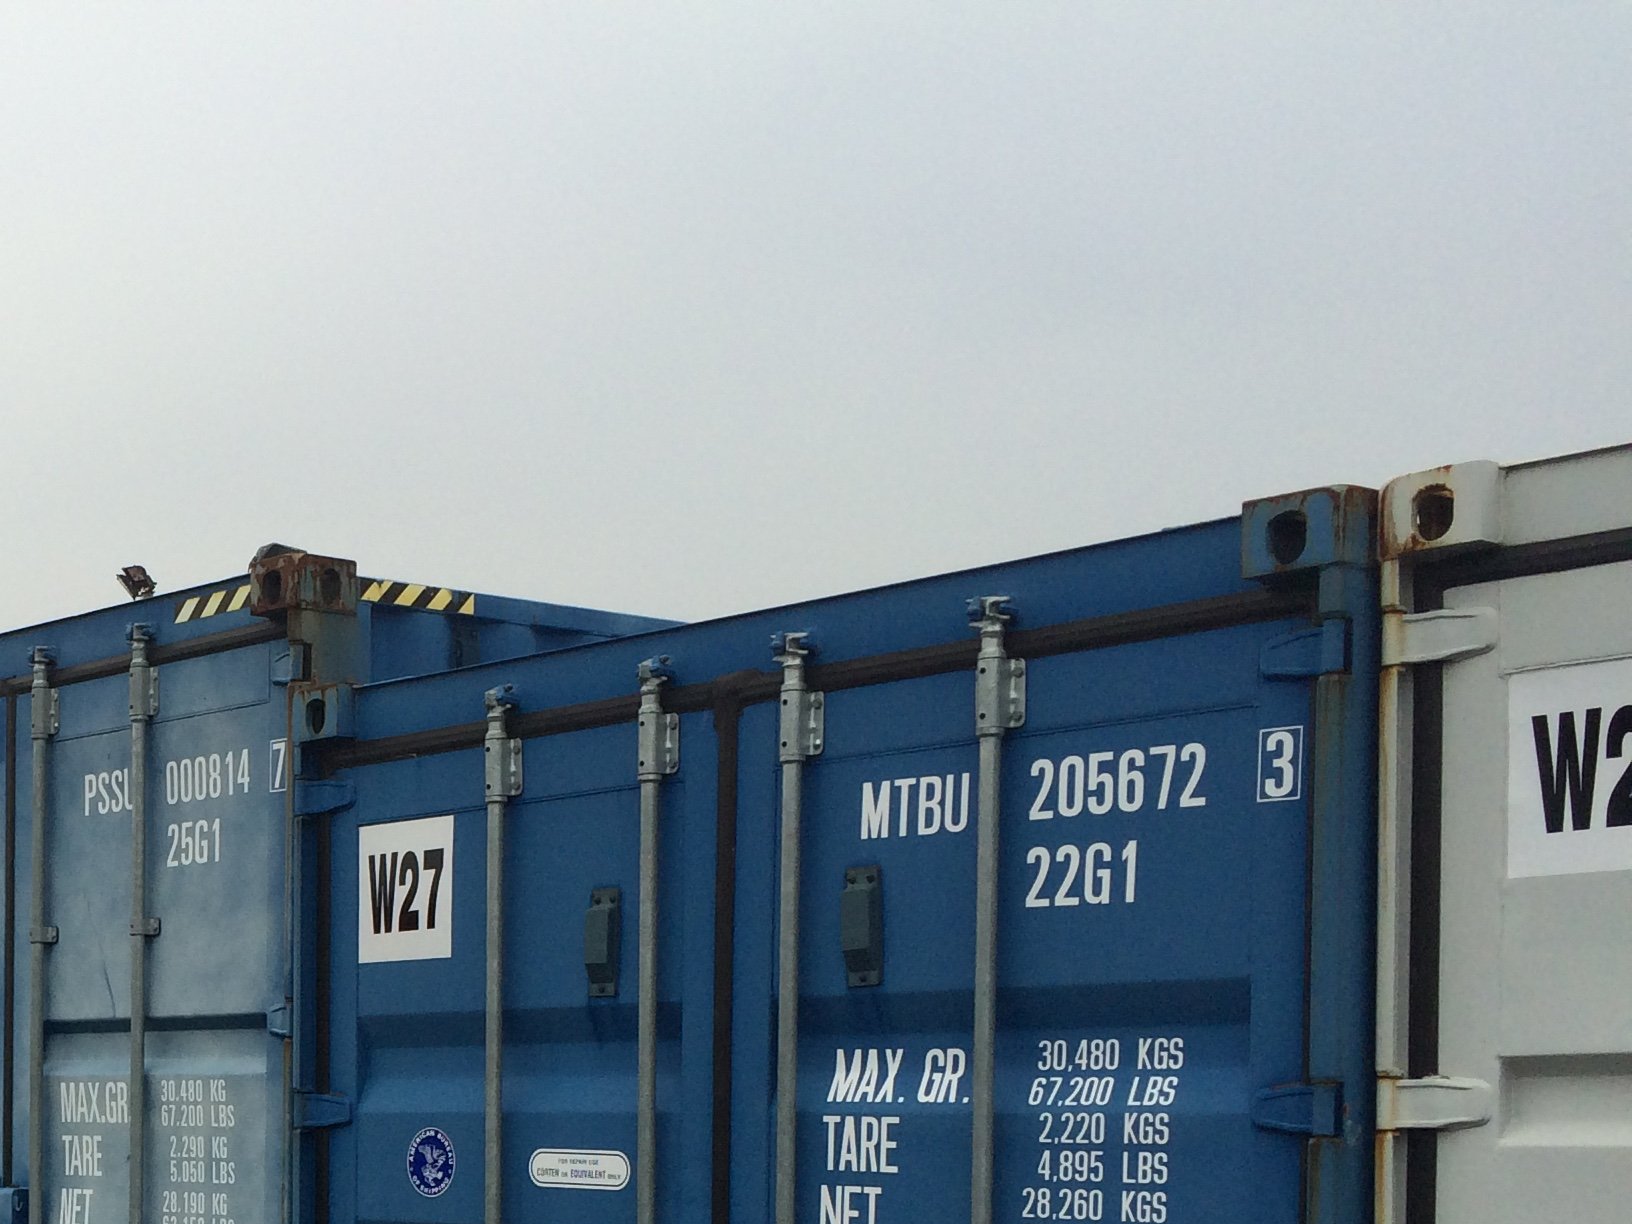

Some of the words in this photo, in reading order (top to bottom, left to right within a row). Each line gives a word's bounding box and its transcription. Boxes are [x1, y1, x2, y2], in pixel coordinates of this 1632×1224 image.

[166, 748, 250, 804] 000814
[272, 742, 286, 789] 7
[861, 773, 970, 839] MTBU
[1029, 742, 1207, 820] 205672
[1263, 730, 1297, 799] 3
[167, 818, 220, 867] 25G1
[368, 847, 445, 934] W27
[1025, 840, 1138, 907] 22G1
[1037, 1039, 1120, 1072] 30,480
[1137, 1038, 1184, 1070] KGS
[161, 1079, 203, 1101] 30.480
[210, 1079, 226, 1101] KG
[827, 1048, 905, 1103] MAX.
[917, 1048, 970, 1103] GR.
[1127, 1076, 1179, 1106] LBS
[161, 1105, 203, 1127] 67.200
[211, 1105, 235, 1127] LBS
[1039, 1112, 1105, 1144] 2,220
[1123, 1112, 1169, 1144] KGS
[62, 1135, 102, 1177] TARE
[170, 1135, 204, 1158] 2.290
[212, 1136, 227, 1158] KG
[409, 1130, 435, 1162] AMERICAN
[823, 1115, 900, 1173] TARE
[212, 1161, 235, 1184] LBS
[537, 1167, 560, 1177] CORTEN
[571, 1169, 606, 1179] EQUIVALENT
[1037, 1150, 1104, 1183] 4,895
[1122, 1151, 1168, 1184] LBS
[212, 1193, 227, 1215] KG
[1022, 1187, 1103, 1221] 28,260
[1121, 1191, 1167, 1223] KGS
